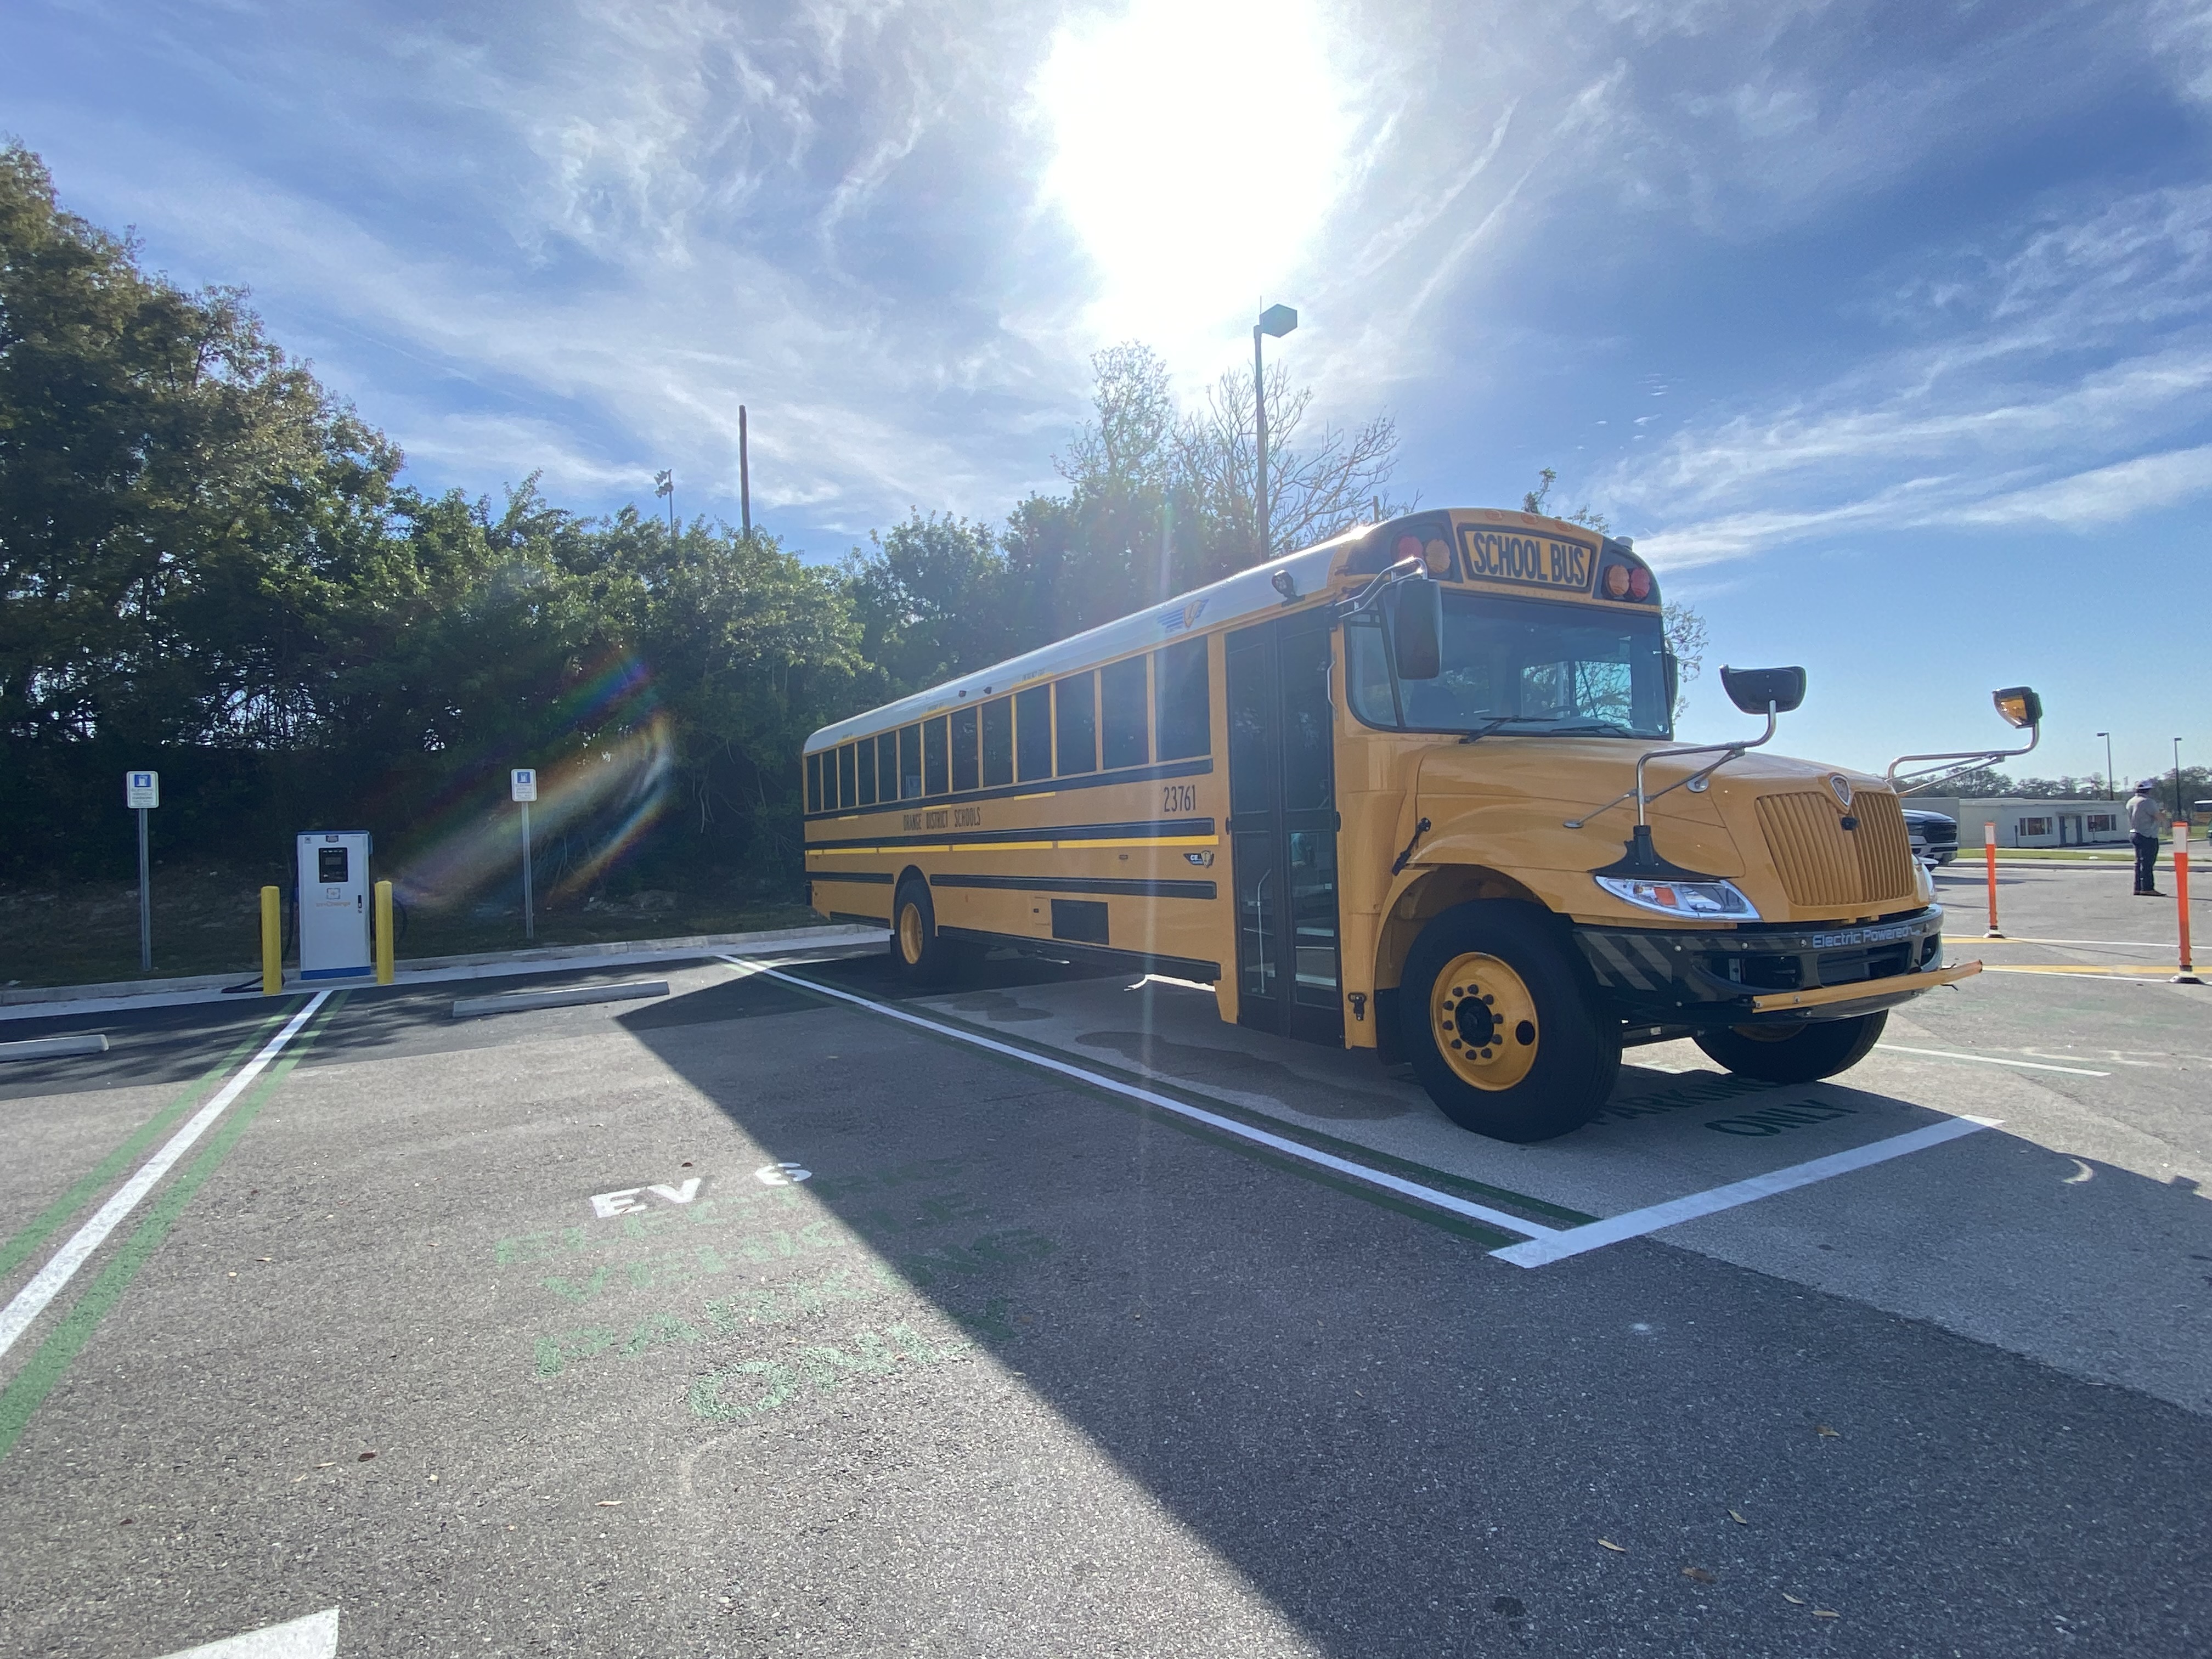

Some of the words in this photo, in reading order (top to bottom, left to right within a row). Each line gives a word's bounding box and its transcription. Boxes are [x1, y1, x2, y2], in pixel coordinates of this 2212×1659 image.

[1474, 532, 1548, 580] SCHOOL
[1551, 543, 1585, 585] BUS
[1163, 785, 1196, 812] 23761
[954, 806, 981, 827] SCHOOLS
[1812, 932, 1861, 948] Electric
[1863, 925, 1912, 943] Powered
[1704, 1099, 1859, 1136] ONLY
[590, 1177, 701, 1218] EV
